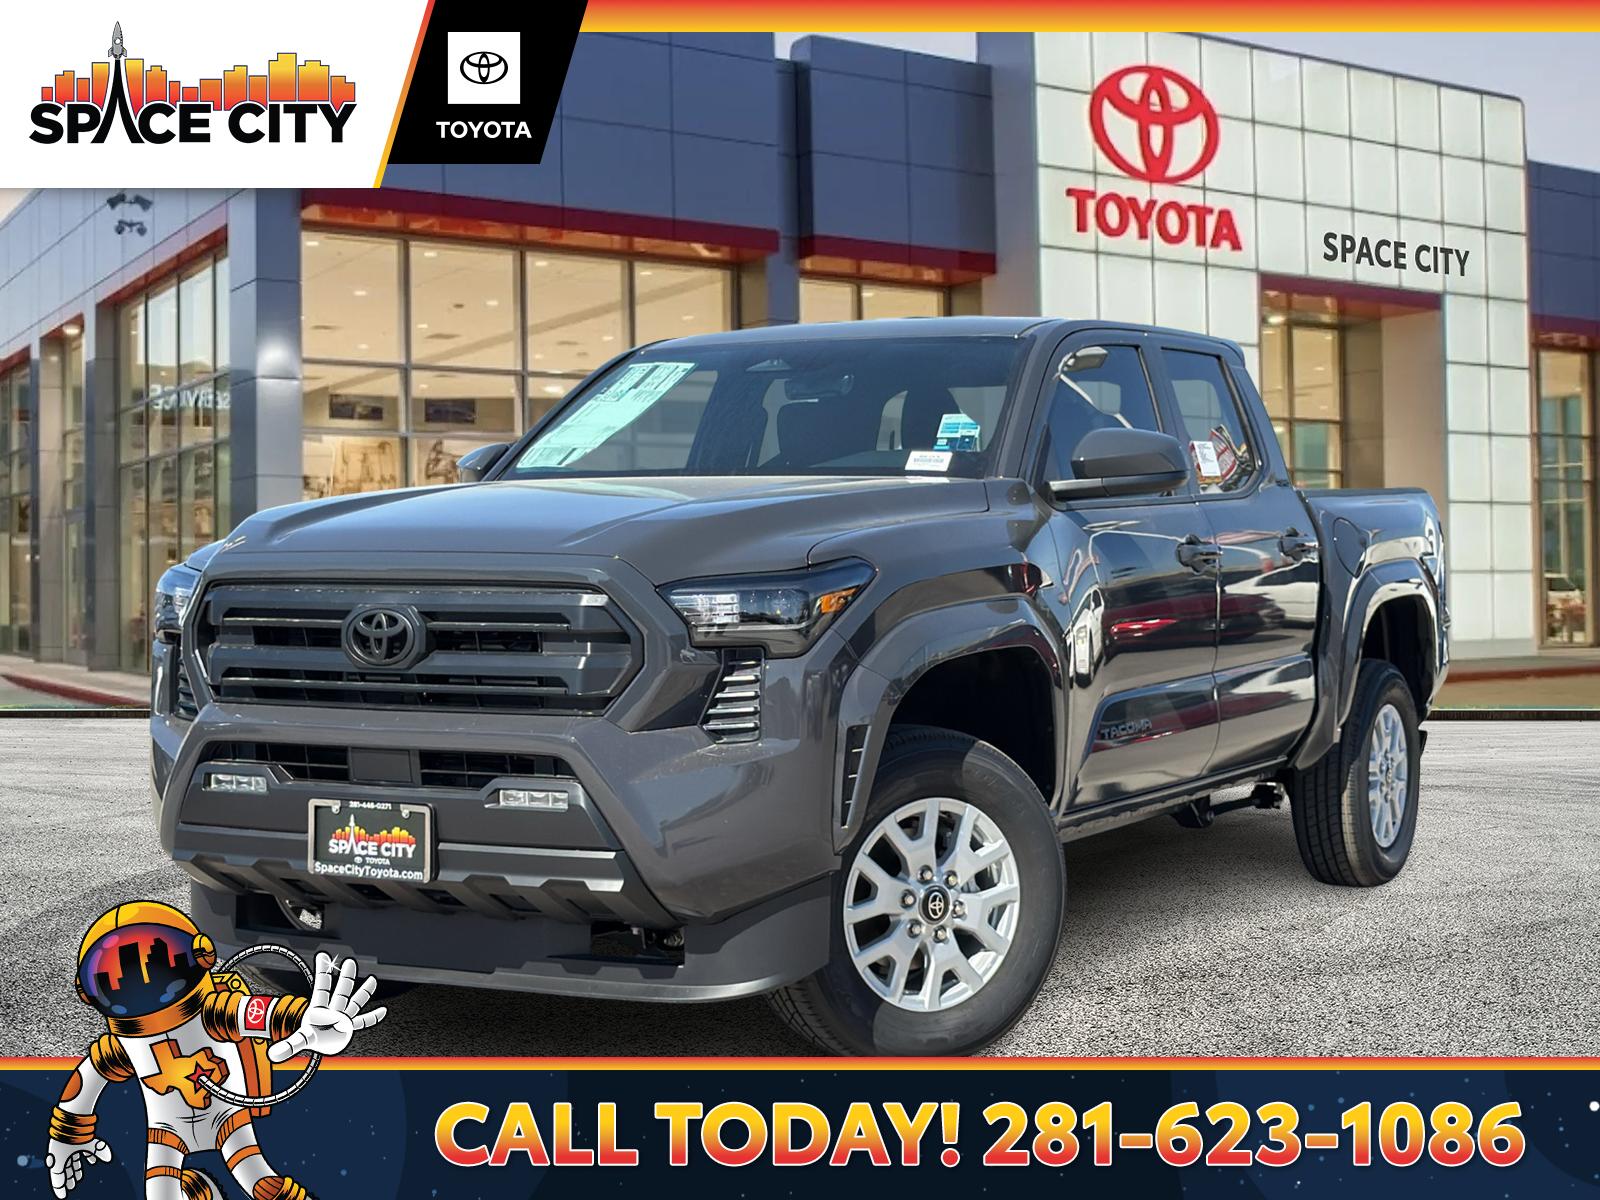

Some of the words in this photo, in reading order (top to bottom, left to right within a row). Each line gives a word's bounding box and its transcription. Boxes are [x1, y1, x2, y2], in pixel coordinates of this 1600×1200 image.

[1066, 187, 1243, 252] TOYOTA
[1322, 231, 1408, 270] SPACE
[1414, 243, 1470, 277] CITY
[1100, 718, 1153, 740] TACOMA
[328, 836, 378, 856] SPACE
[380, 842, 417, 858] CITY
[314, 861, 423, 880] SpaceCityToyota.com
[365, 856, 391, 866] TOYOTA
